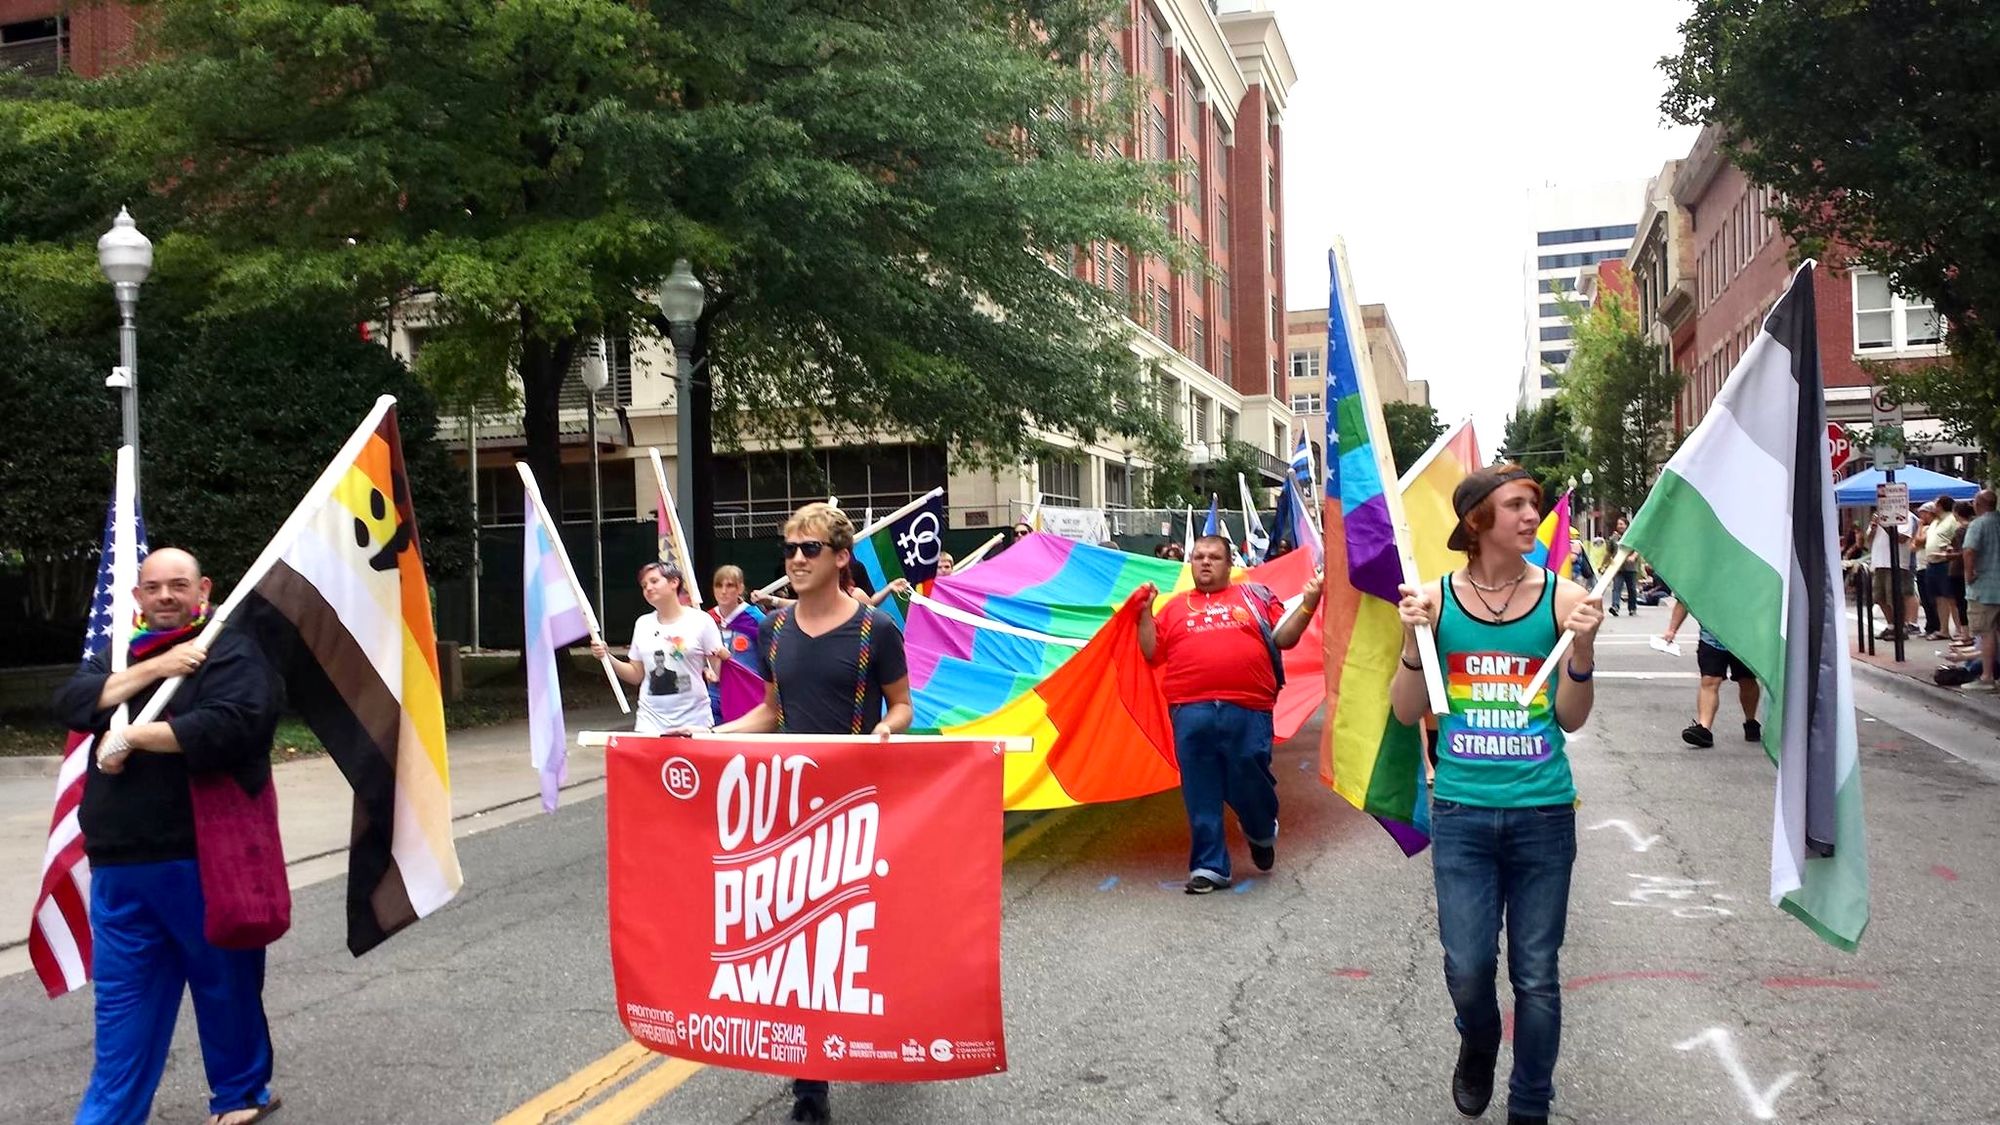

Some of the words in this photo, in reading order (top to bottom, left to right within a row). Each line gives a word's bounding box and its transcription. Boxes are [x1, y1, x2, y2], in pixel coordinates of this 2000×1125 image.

[1829, 438, 1848, 457] OP
[1465, 655, 1530, 676] CAN'T
[1472, 682, 1525, 703] EVEN
[1464, 708, 1530, 729] THINK
[1452, 733, 1543, 756] STRAIGHT
[669, 767, 693, 790] BE
[716, 753, 824, 851] OUT.
[714, 802, 890, 945] PROUD.
[708, 901, 885, 1015] AWARE.
[626, 1003, 675, 1024] PROMOTING
[676, 1020, 687, 1040] &
[688, 1013, 772, 1060] POSITIVE
[771, 1021, 808, 1046] SEXUAL
[771, 1044, 808, 1065] IDENTITY
